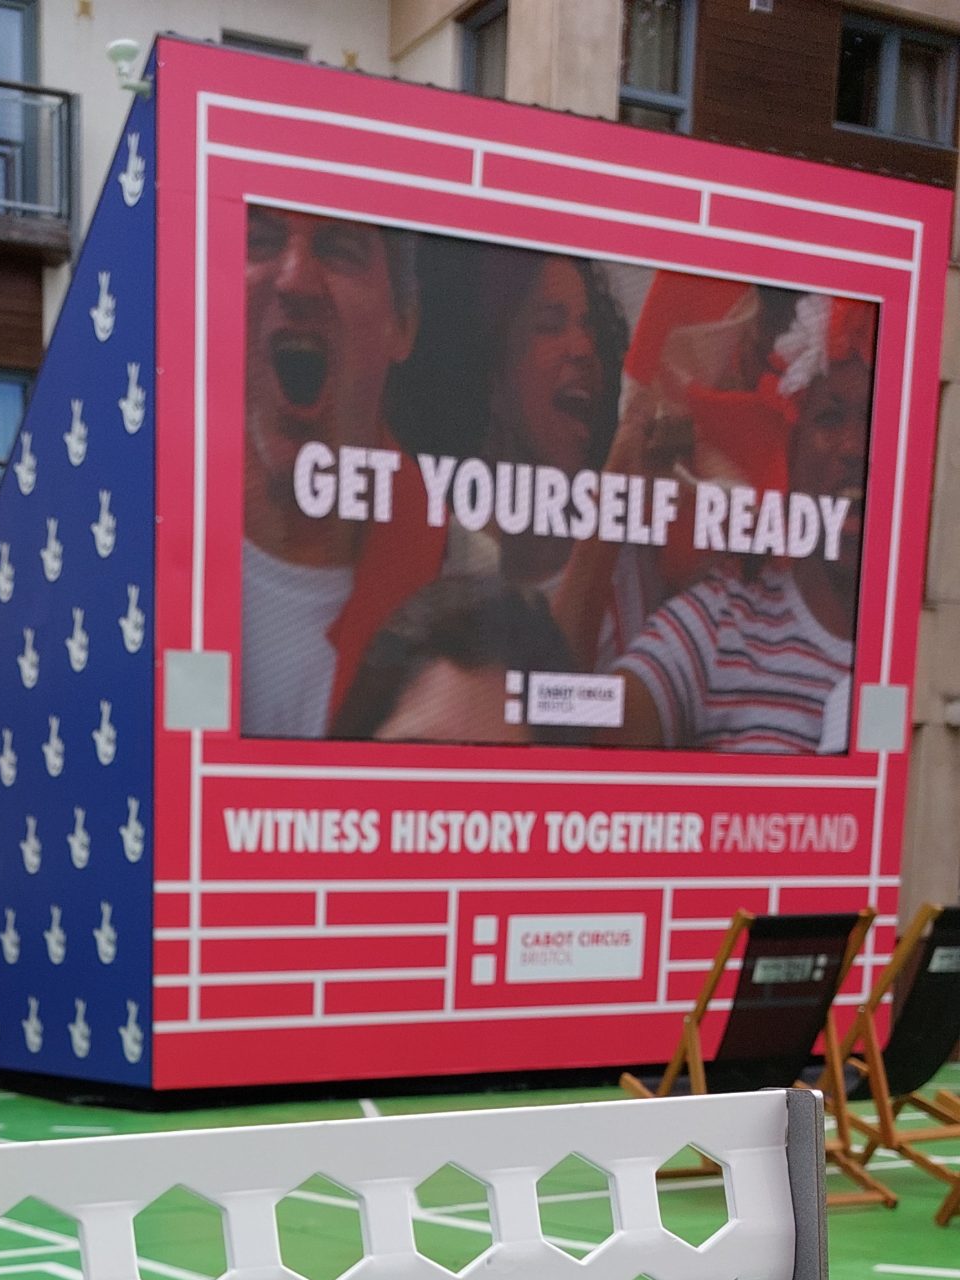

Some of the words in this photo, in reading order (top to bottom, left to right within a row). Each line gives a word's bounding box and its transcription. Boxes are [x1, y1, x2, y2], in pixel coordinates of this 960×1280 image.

[293, 440, 401, 523] GET
[416, 453, 680, 546] YOURSELF
[693, 480, 851, 561] READY
[224, 808, 380, 853] WITNESS
[391, 810, 537, 854] HISTORY
[544, 810, 704, 854] TOGETHER
[710, 812, 859, 853] FANSTAND
[520, 931, 573, 948] CABOT
[577, 928, 632, 947] CIRCUS
